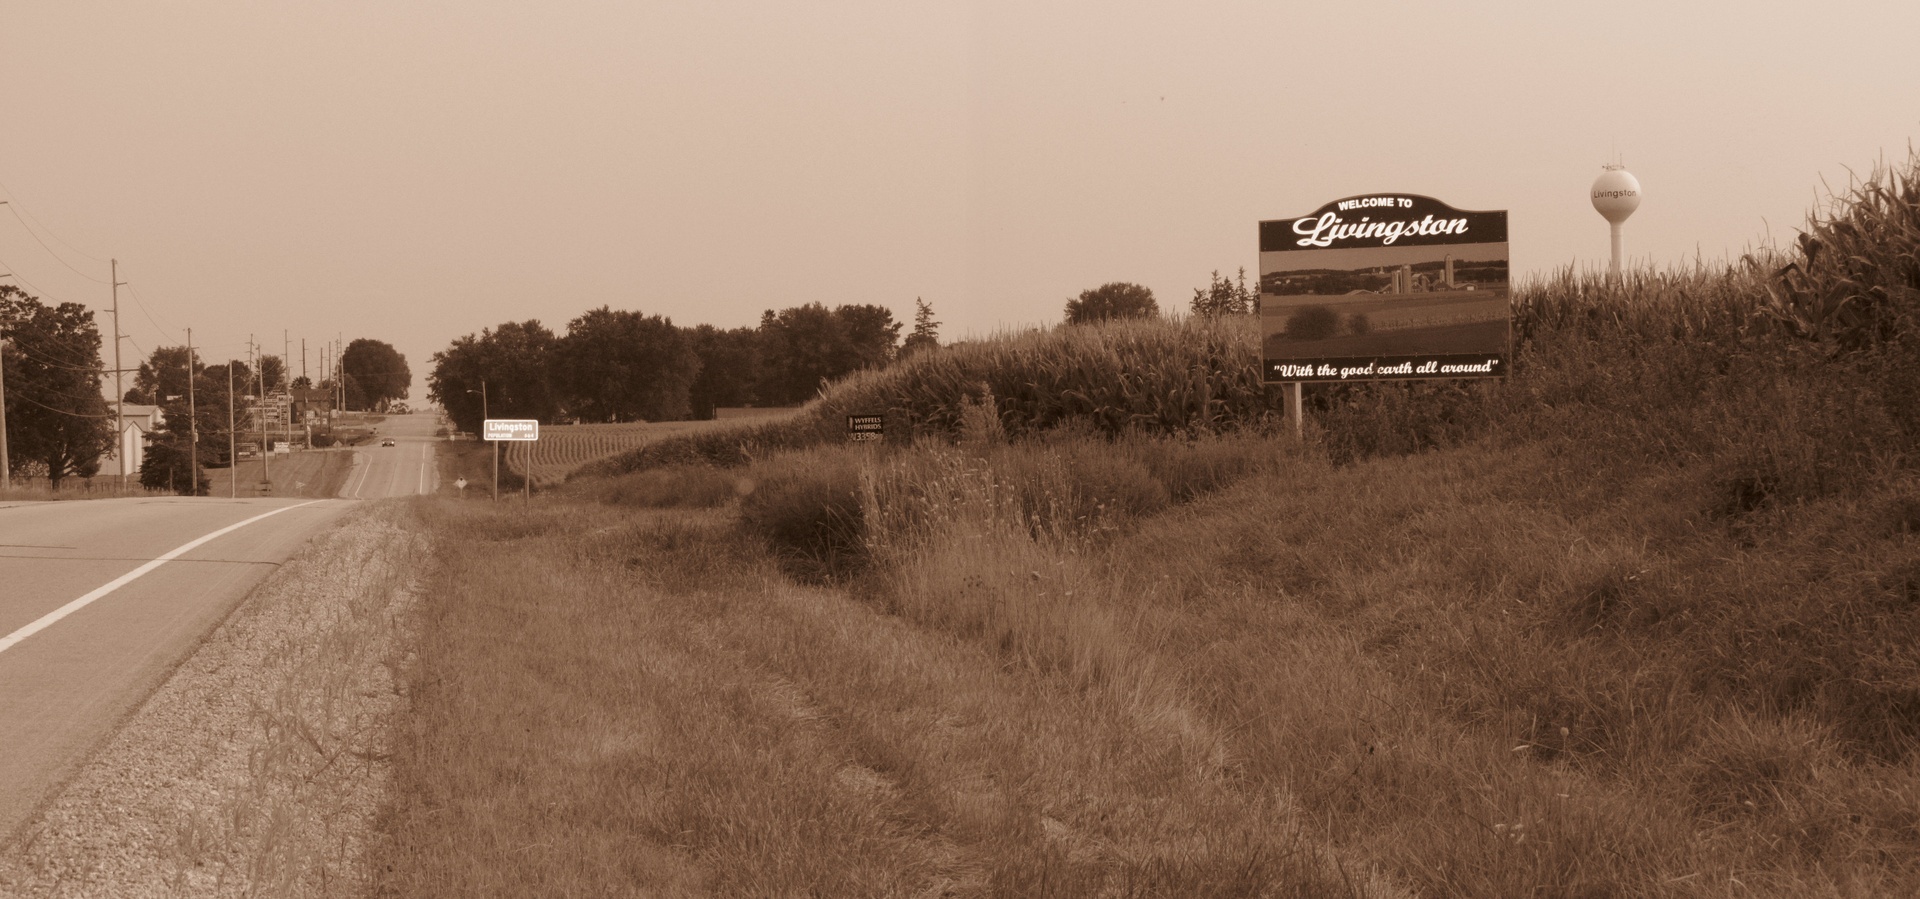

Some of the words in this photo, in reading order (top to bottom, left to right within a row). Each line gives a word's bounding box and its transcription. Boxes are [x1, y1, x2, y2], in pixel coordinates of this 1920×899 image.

[1593, 190, 1637, 199] Livingston
[1338, 197, 1394, 211] WELCOME
[1397, 198, 1413, 208] TO
[1292, 211, 1469, 247] Livingston
[1273, 364, 1315, 378] "With
[1316, 363, 1338, 377] the
[1340, 362, 1375, 380] good
[1377, 361, 1413, 375] earth
[1415, 360, 1438, 374] all
[1440, 359, 1499, 374] around"
[489, 422, 533, 433] Livingston
